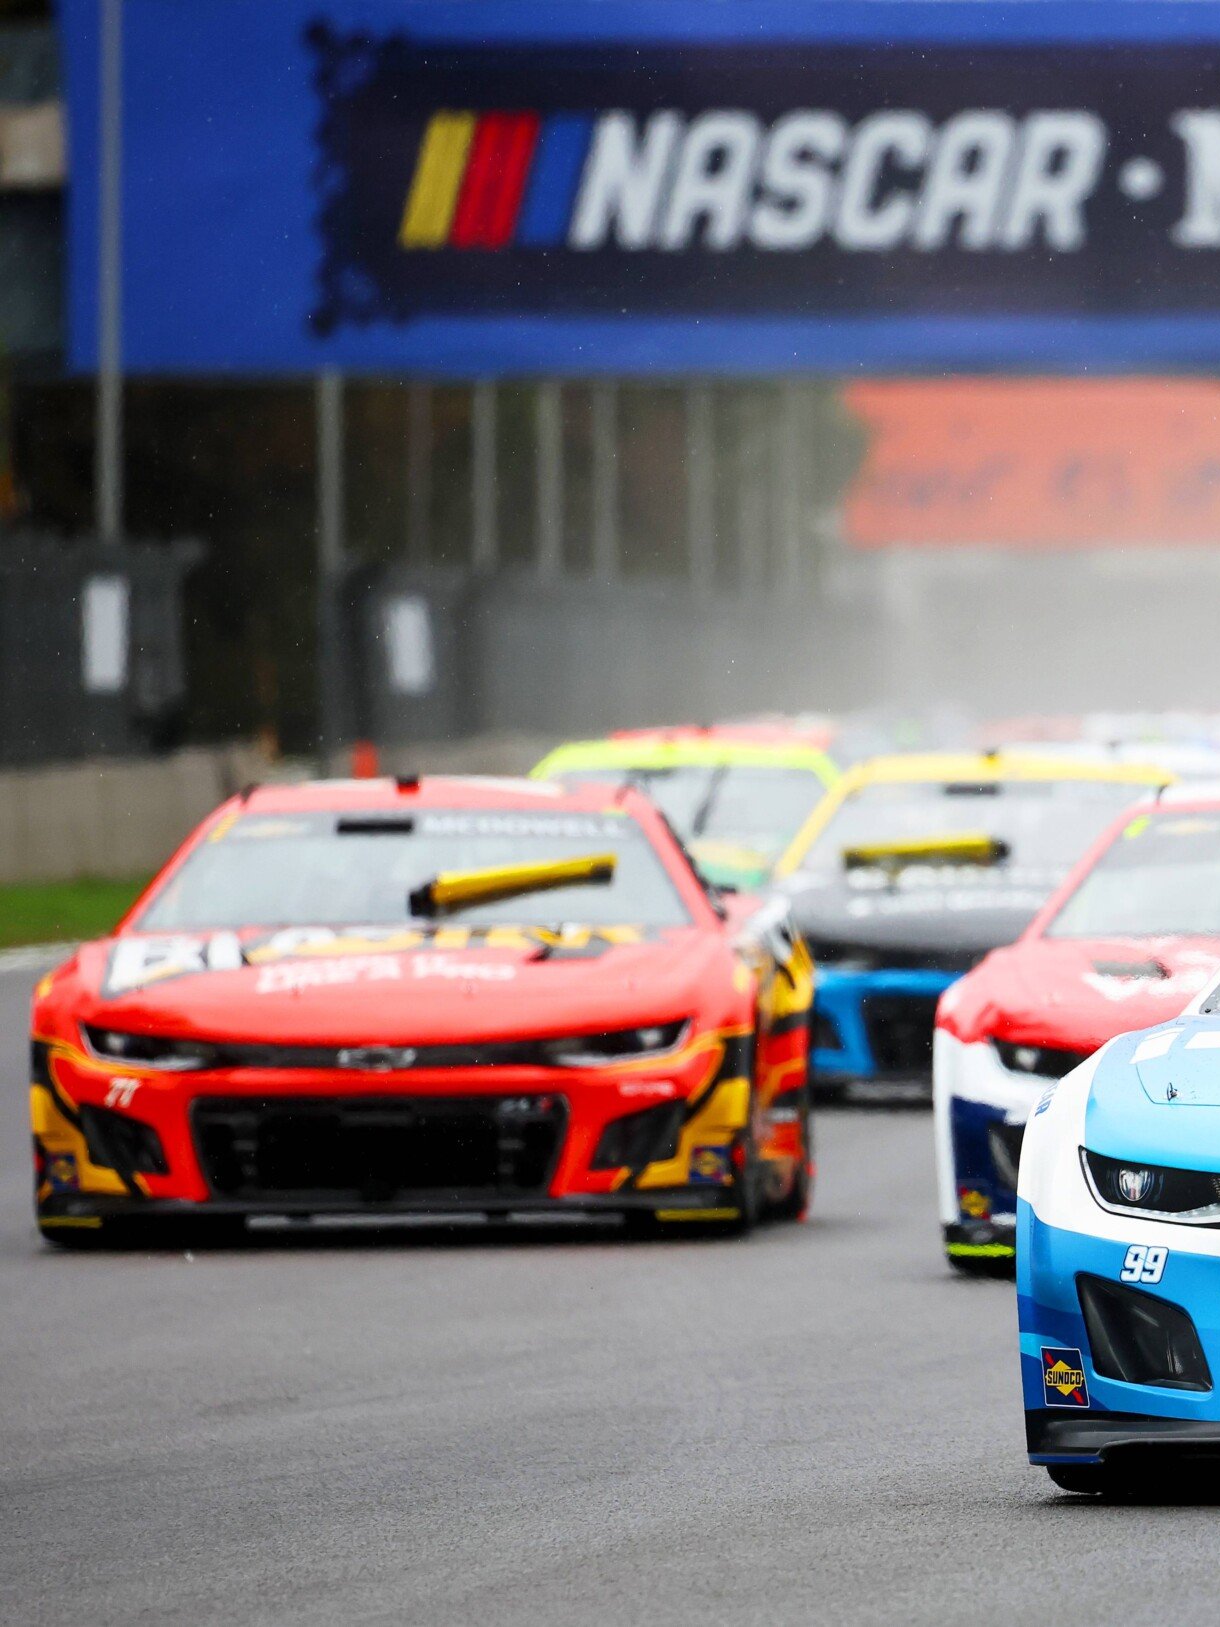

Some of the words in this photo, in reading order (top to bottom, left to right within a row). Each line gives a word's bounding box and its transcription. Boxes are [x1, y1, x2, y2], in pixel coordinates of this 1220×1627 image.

[569, 108, 1106, 251] NASCAR
[1120, 1245, 1169, 1284] 99
[1046, 1369, 1082, 1387] SUNOCO
